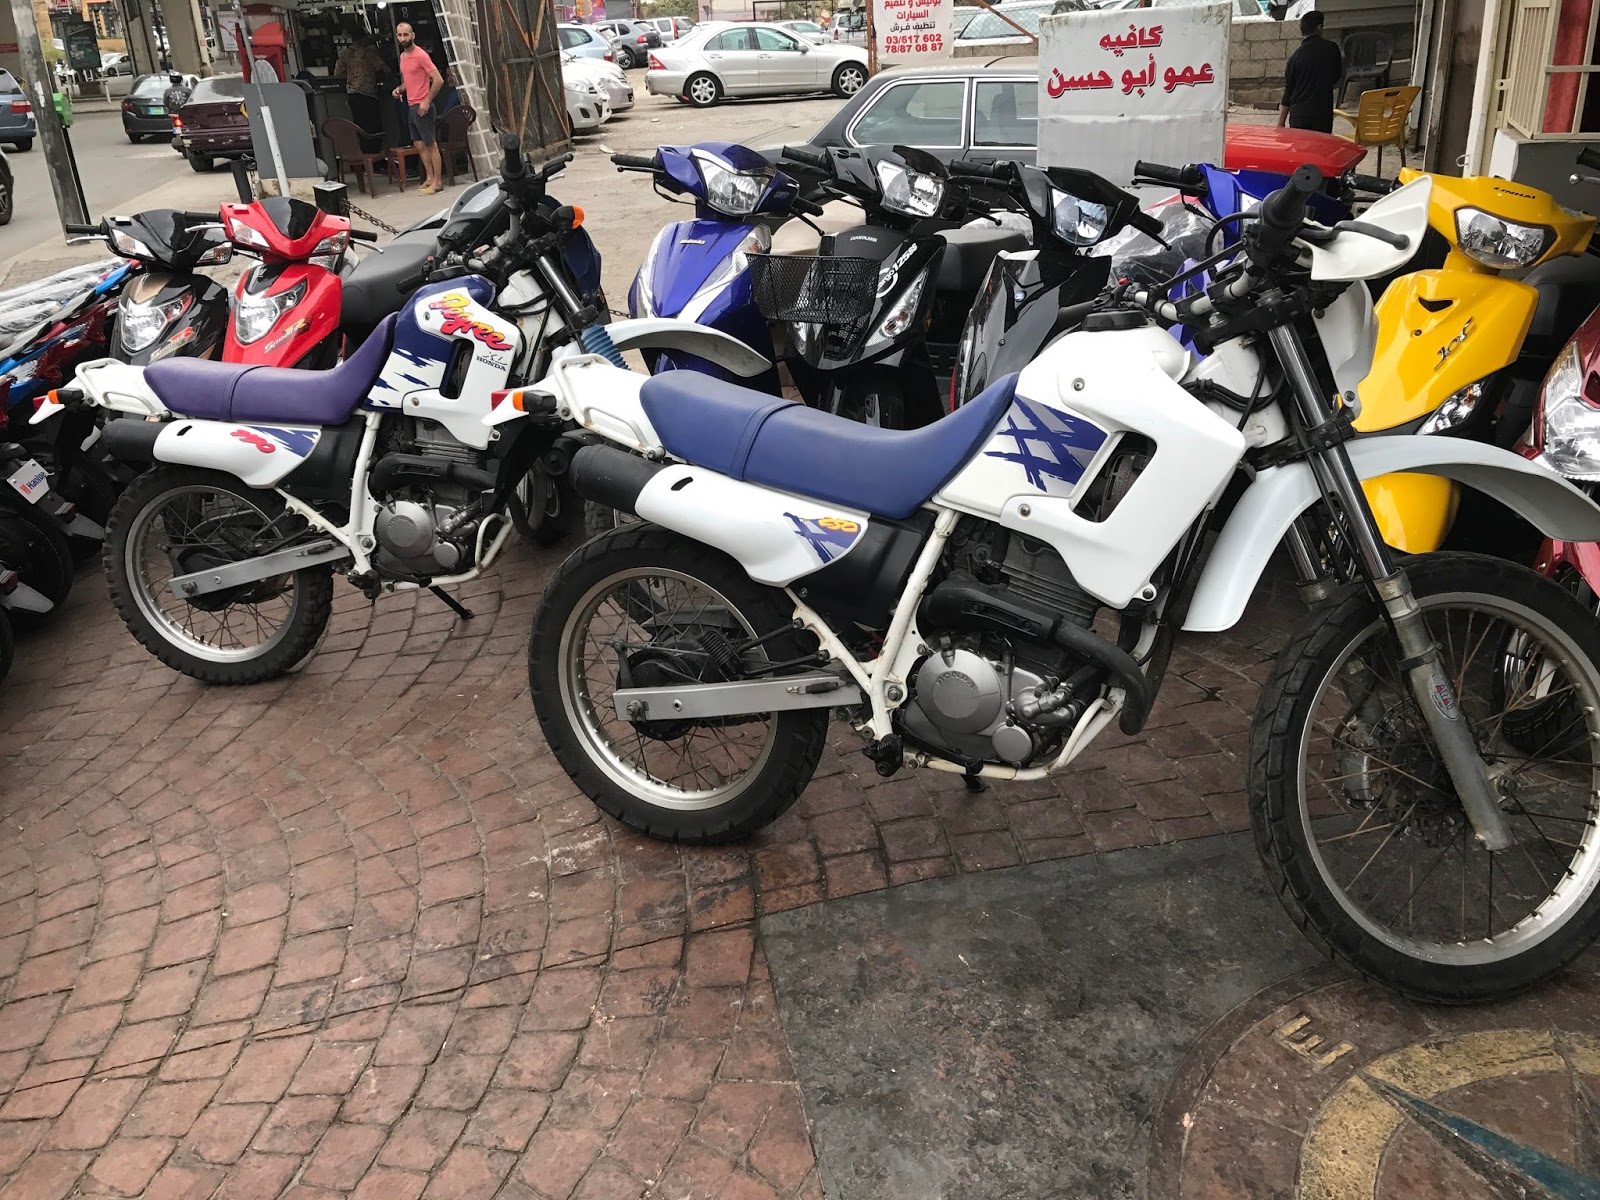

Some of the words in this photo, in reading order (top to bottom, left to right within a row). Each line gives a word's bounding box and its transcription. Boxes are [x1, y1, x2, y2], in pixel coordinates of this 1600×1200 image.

[896, 10, 929, 21] السيارات
[912, 21, 936, 31] تنظيف
[885, 45, 912, 53] 78/87
[915, 44, 928, 52] 08
[930, 42, 944, 51] 87
[886, 35, 920, 44] 03/617
[922, 33, 942, 43] 602
[1099, 24, 1164, 58] كافيه
[1047, 67, 1115, 99] حسن
[1121, 53, 1158, 98] أبو
[1163, 62, 1215, 94] عمو
[1493, 186, 1536, 199] LINHAI
[428, 293, 514, 351] Degree
[476, 355, 507, 372] HONDA
[26, 471, 47, 490] Haojue
